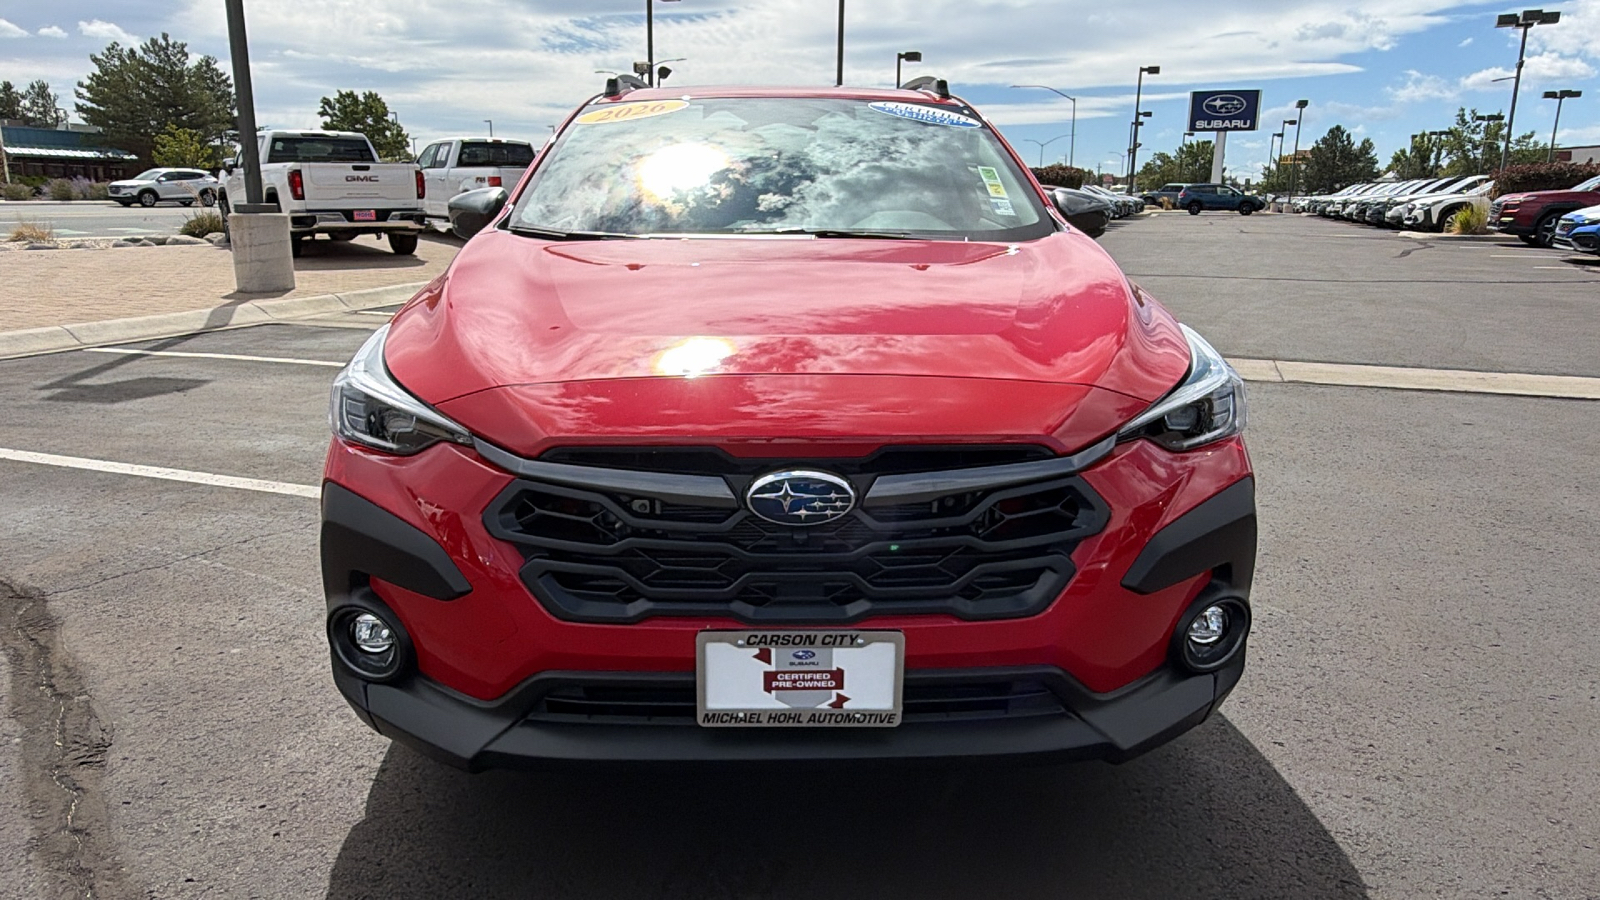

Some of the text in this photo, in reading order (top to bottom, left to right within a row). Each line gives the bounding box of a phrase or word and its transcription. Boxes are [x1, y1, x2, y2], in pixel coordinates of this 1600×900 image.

[594, 103, 666, 122] 2026
[1195, 119, 1251, 129] SUBARU
[746, 634, 860, 646] CARSON CITY
[777, 673, 831, 681] CERTIFIED
[771, 680, 836, 688] PRE-OWNED
[702, 712, 897, 724] MICHAEL HOHL AUTOMOTIVE
